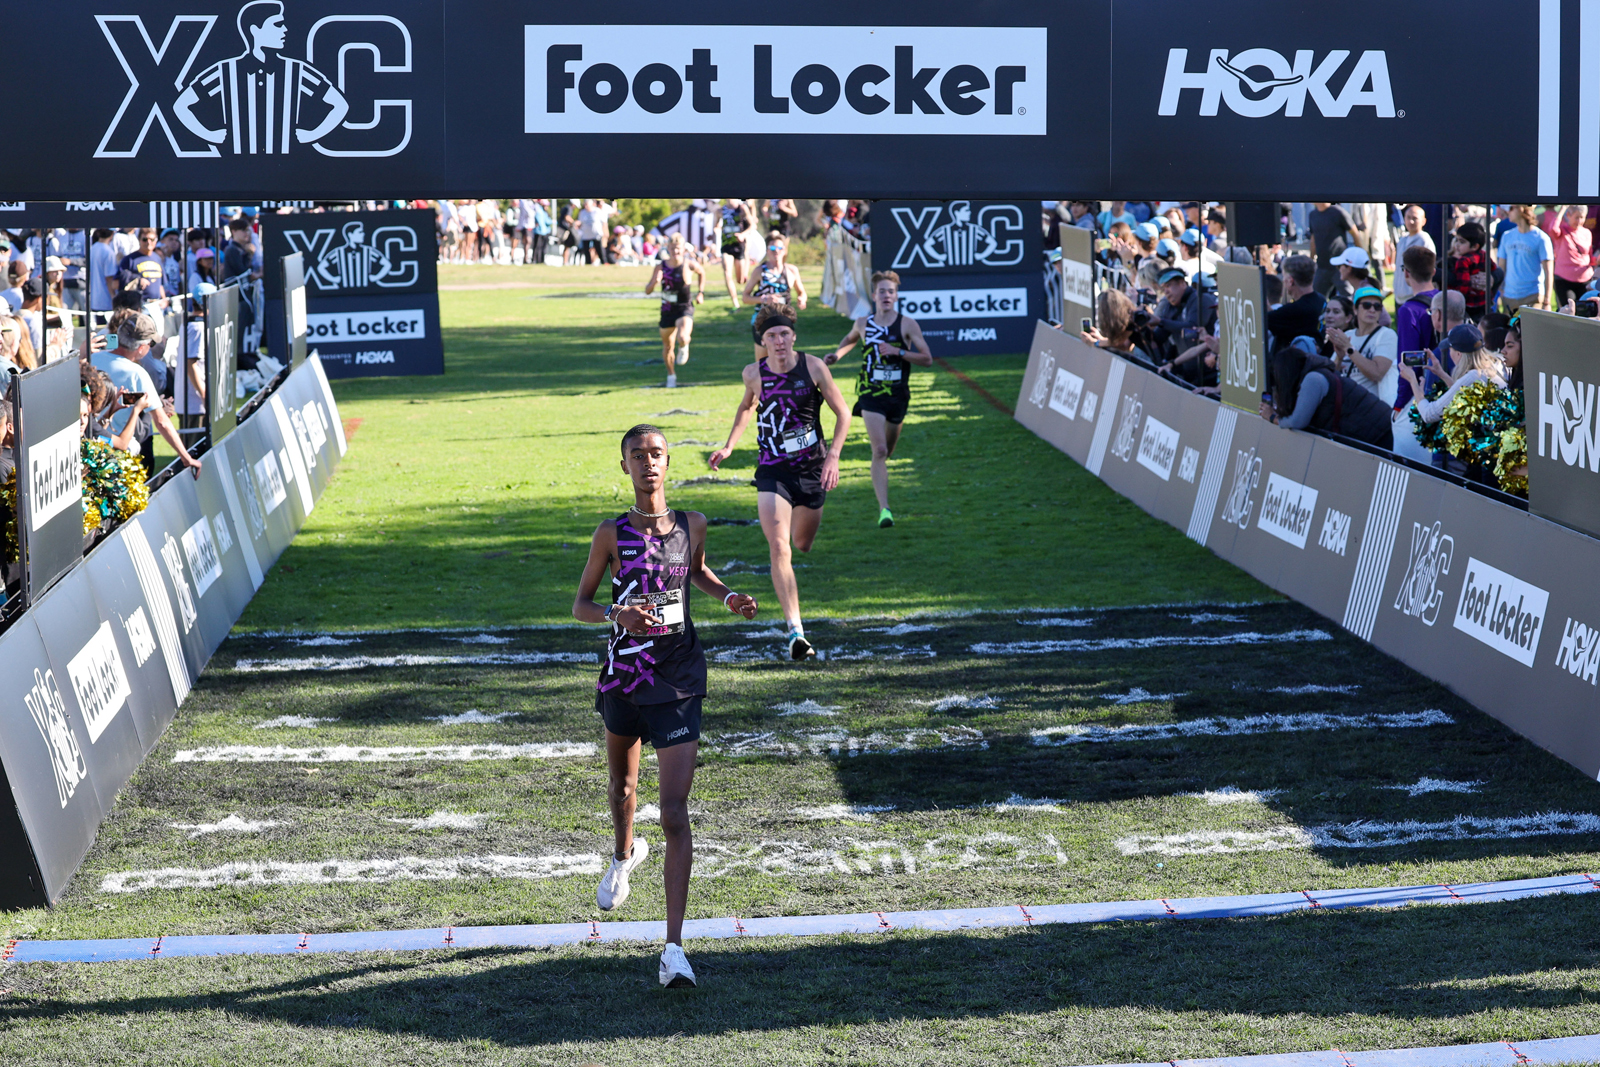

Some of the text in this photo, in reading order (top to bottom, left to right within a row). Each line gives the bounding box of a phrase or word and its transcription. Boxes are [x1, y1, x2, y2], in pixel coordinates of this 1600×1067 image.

[546, 44, 1027, 116] Foot Locker
[1158, 48, 1397, 118] HOKA
[898, 294, 1022, 314] Foot Locker
[306, 316, 419, 338] oot Locker
[957, 327, 997, 342] HOKA
[355, 350, 396, 365] HOKA
[795, 387, 811, 396] WEST
[1537, 371, 1600, 475] HOK
[796, 435, 809, 449] 90
[33, 454, 53, 514] Foot
[1261, 482, 1311, 537] Foot Locker
[1318, 507, 1352, 557] HOKA
[669, 566, 690, 577] WEST
[1459, 570, 1540, 652] Foot Locker
[646, 625, 669, 635] 2023
[1555, 617, 1600, 686] HOKA
[666, 726, 691, 742] HOKA
